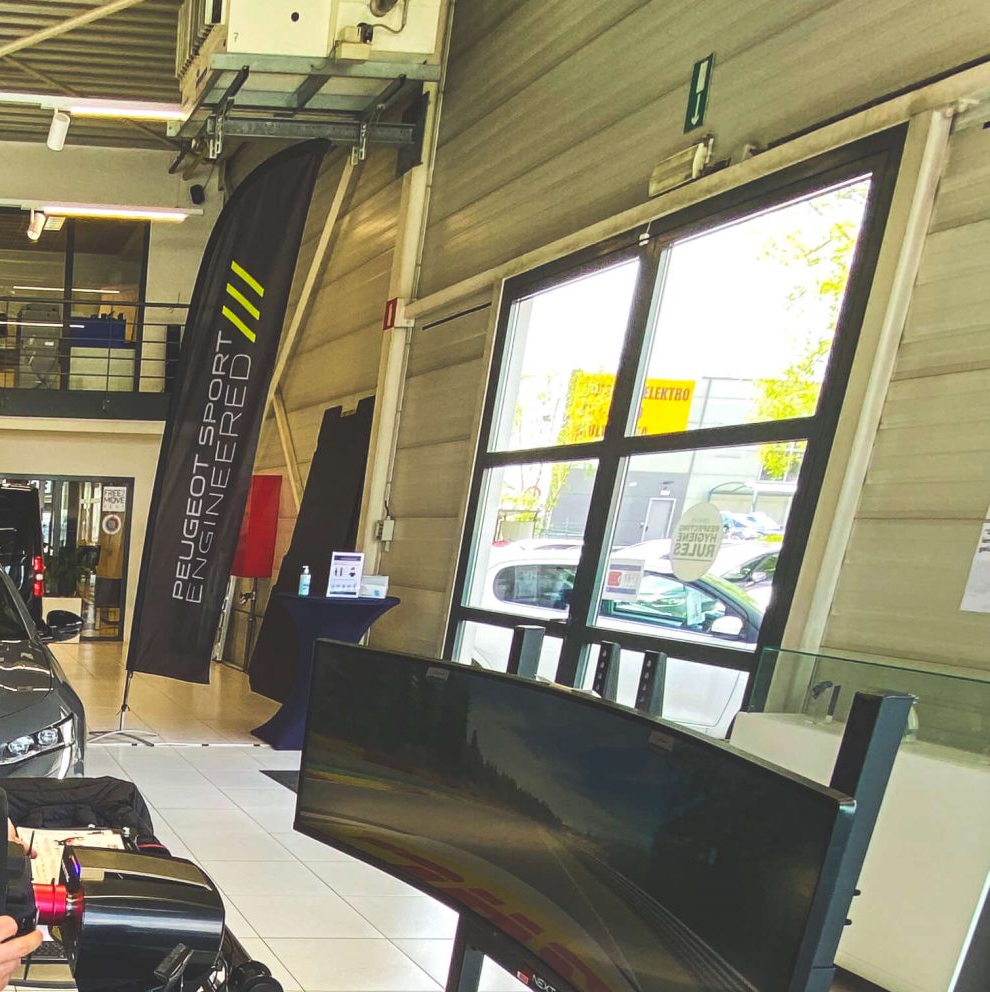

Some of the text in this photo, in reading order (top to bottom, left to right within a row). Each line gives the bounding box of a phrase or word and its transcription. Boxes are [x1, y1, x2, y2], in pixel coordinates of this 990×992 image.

[172, 330, 232, 600] PEUGEOT SPORT
[186, 354, 252, 604] ENGINEERED
